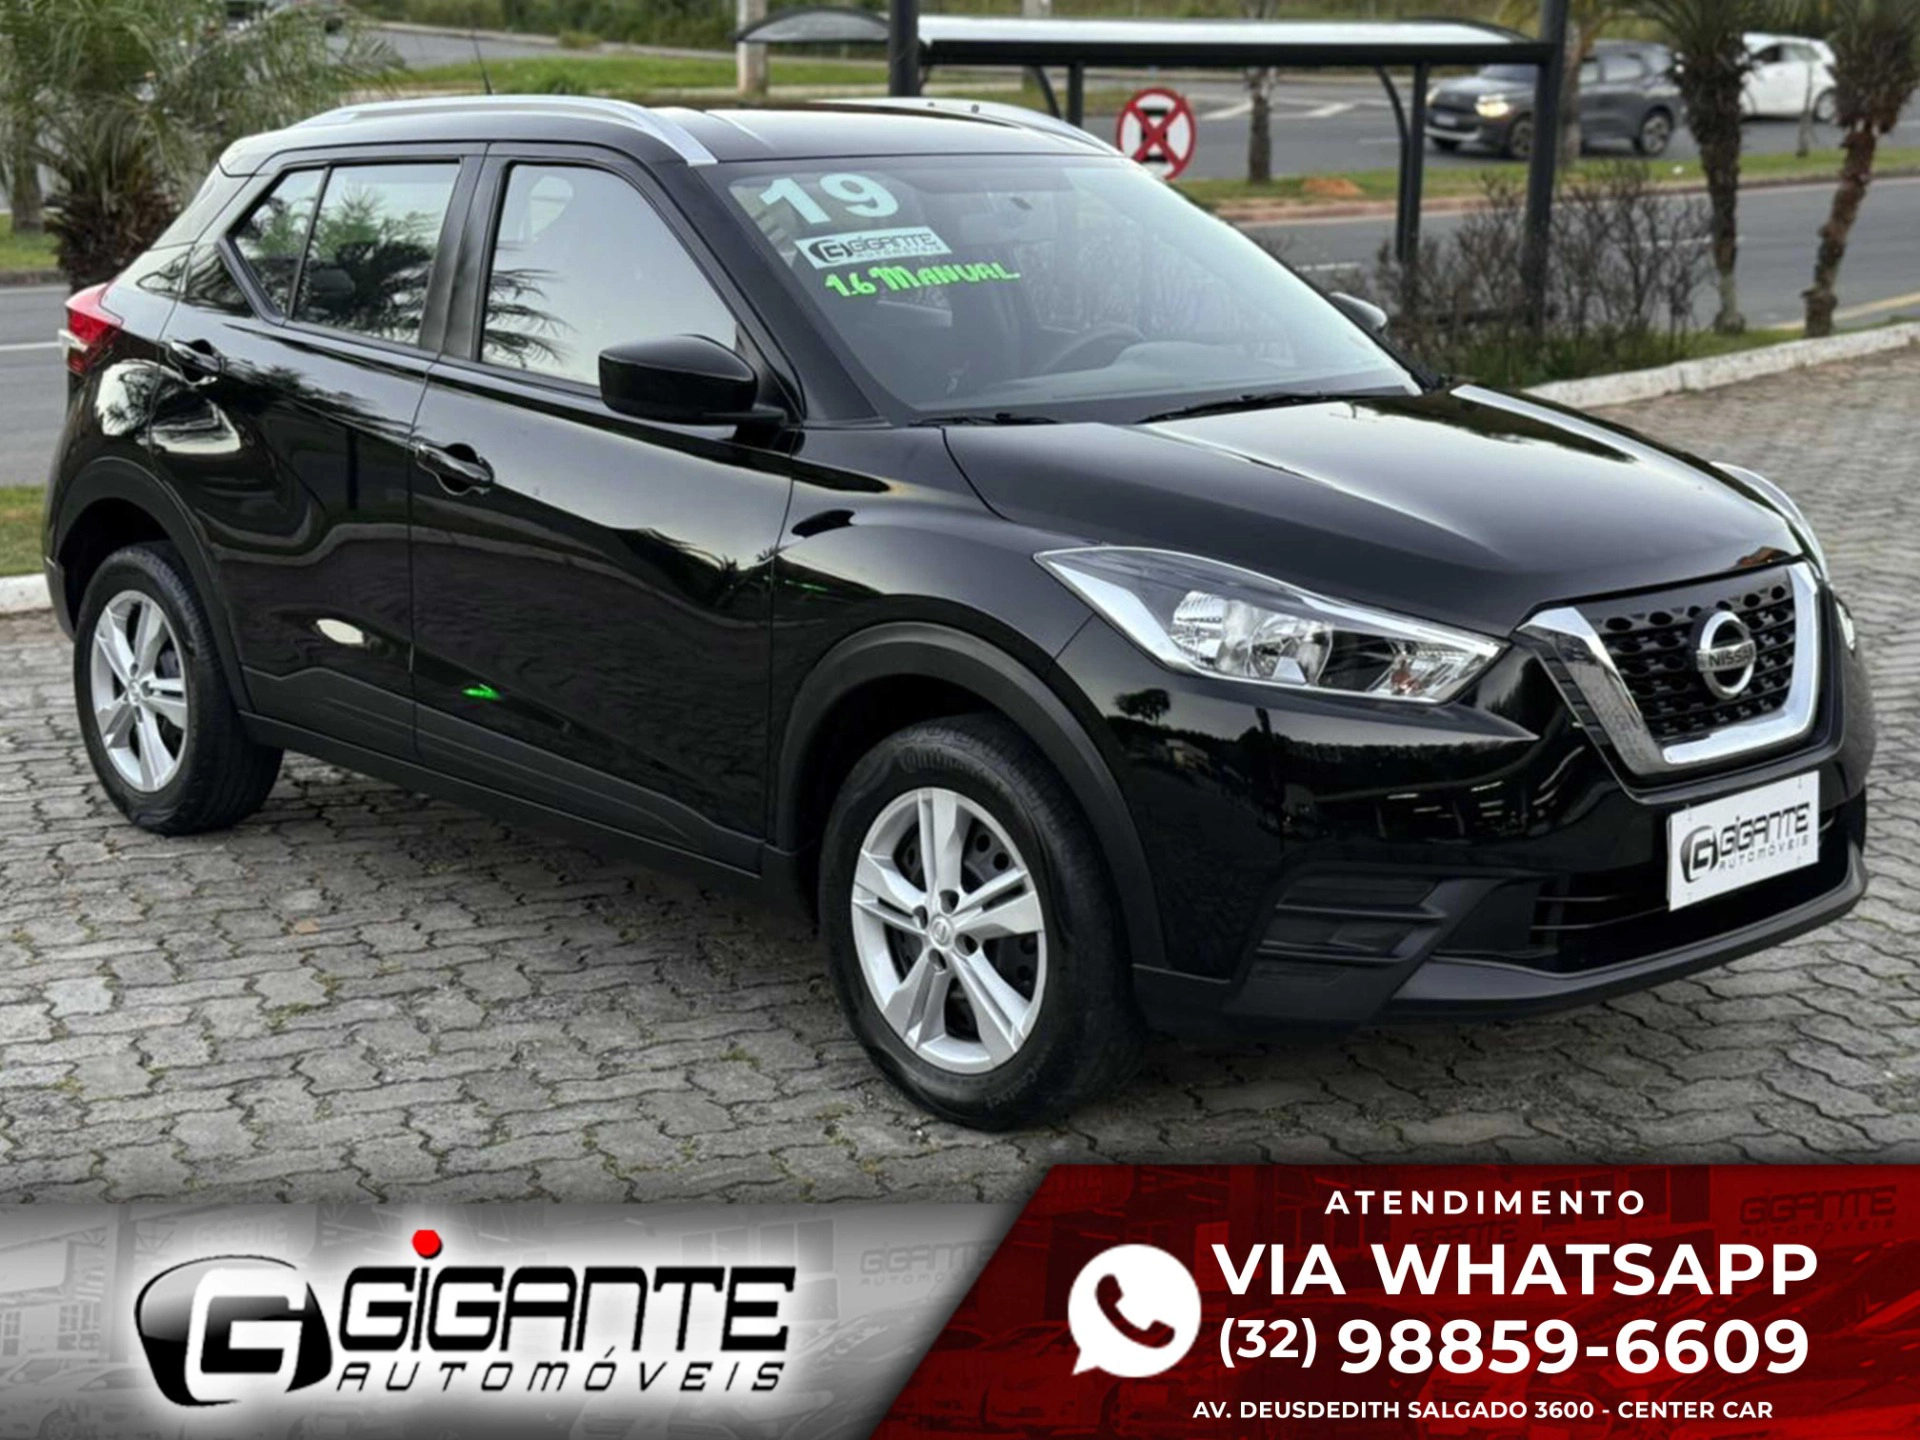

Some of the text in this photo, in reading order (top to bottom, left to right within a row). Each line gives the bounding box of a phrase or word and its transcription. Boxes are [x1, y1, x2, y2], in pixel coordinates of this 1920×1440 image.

[759, 173, 898, 224] 19
[825, 262, 1021, 297] 1.6 MANUAL
[1720, 802, 1810, 857] GIGANTE
